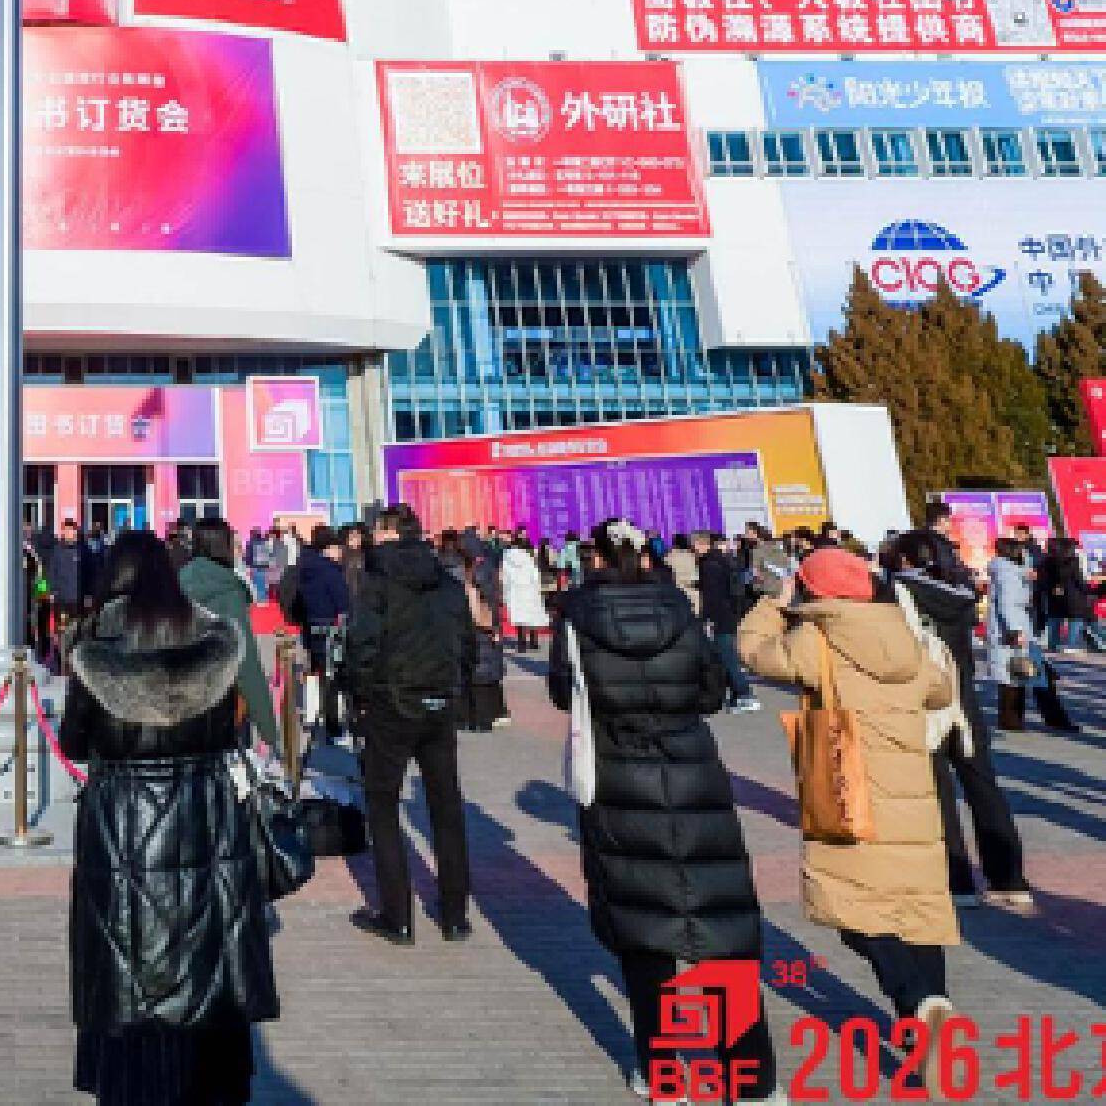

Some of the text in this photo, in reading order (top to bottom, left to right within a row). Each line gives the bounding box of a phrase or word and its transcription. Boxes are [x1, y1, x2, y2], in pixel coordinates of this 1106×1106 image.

[646, 13, 988, 44] 防伪溯源系统提供商
[843, 78, 990, 109] 阳光少年报
[559, 91, 682, 132] 外研社
[399, 160, 485, 190] 来展位
[402, 198, 490, 229] 送好礼
[1018, 233, 1106, 261] 中国外
[232, 466, 295, 496] BBF
